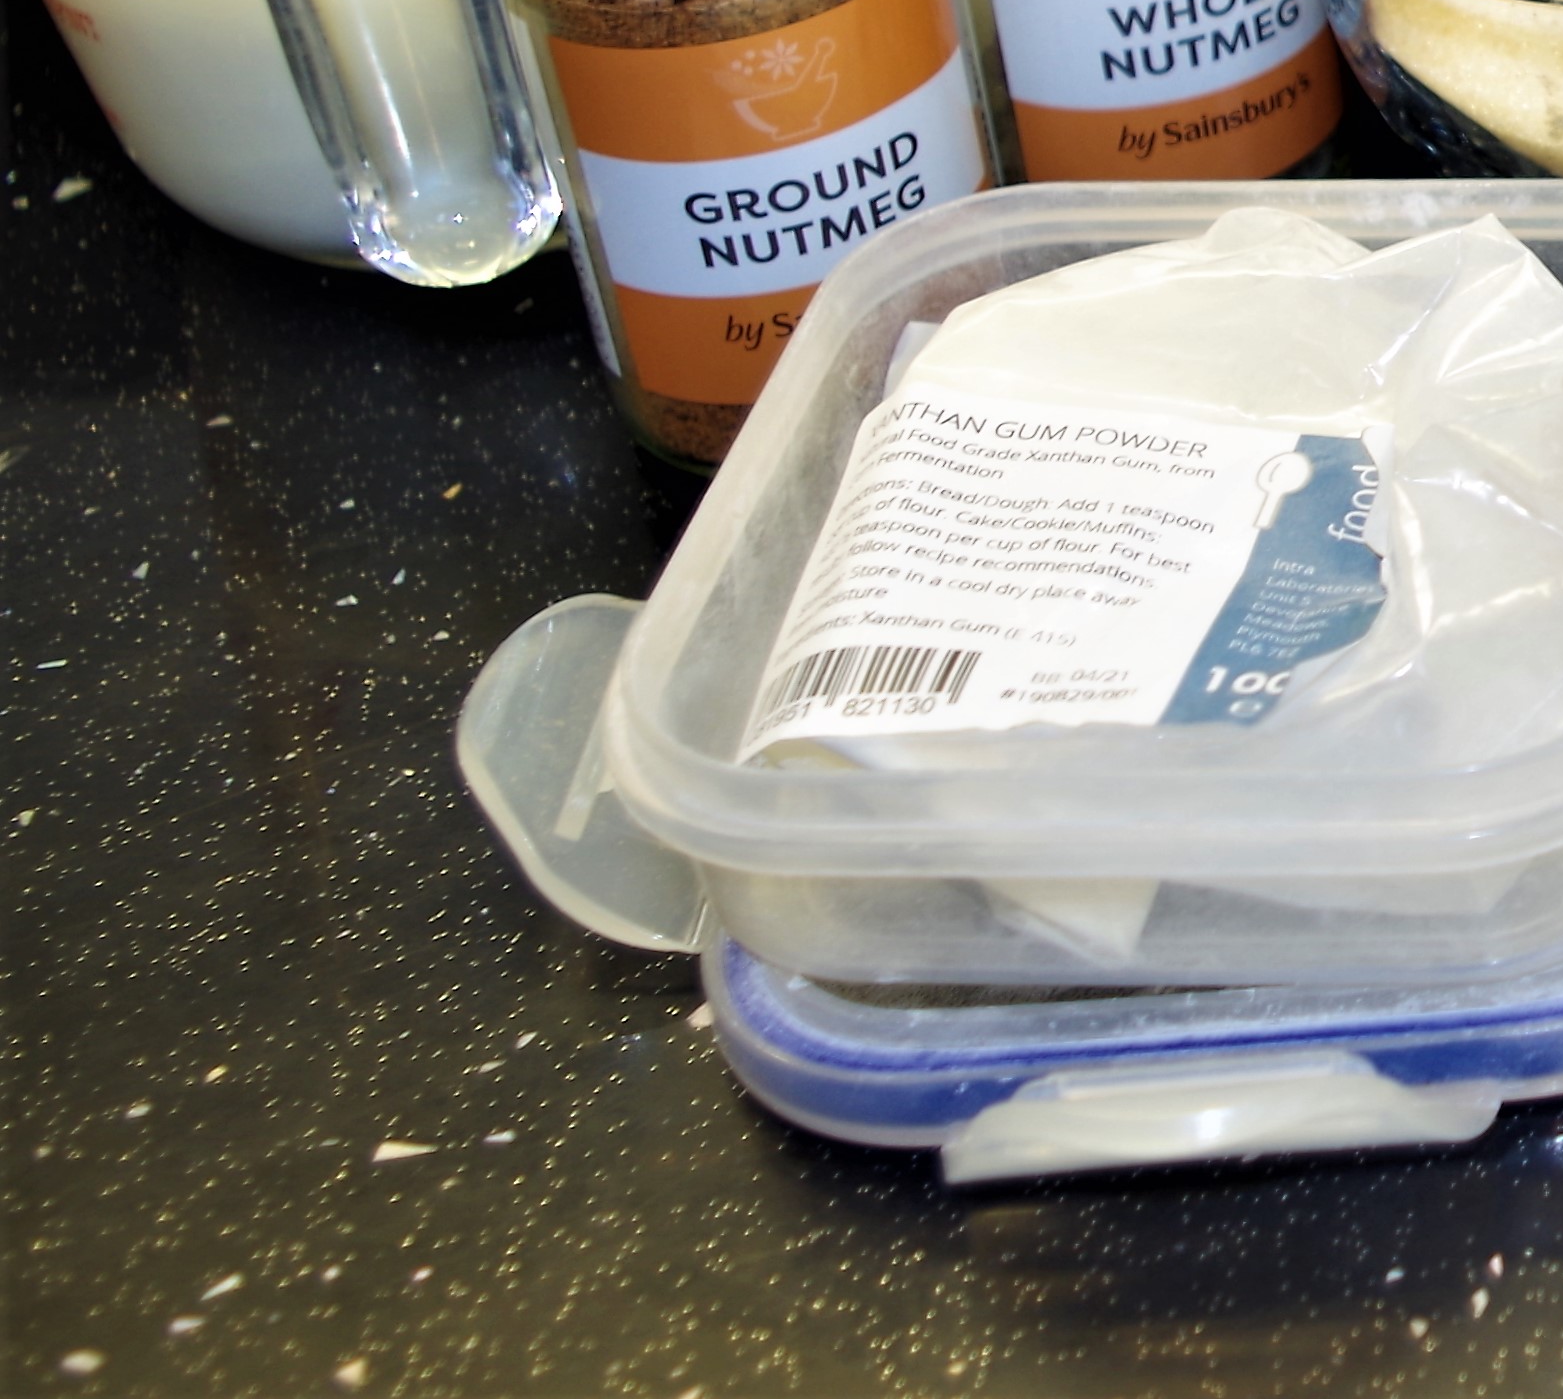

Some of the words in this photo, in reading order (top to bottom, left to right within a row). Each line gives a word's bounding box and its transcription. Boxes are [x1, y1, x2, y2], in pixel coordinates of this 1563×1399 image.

[1117, 125, 1158, 159] by
[1163, 73, 1311, 148] Sainsbury's
[685, 131, 919, 225] GROUND
[699, 174, 926, 269] NUTMEG
[725, 315, 764, 351] by
[908, 429, 957, 450] Food
[962, 442, 1019, 461] Grade
[1025, 449, 1106, 466] Xanthan
[1169, 463, 1216, 480] from
[994, 420, 1068, 441] GUM
[1075, 426, 1208, 459] POWDER
[875, 496, 898, 511] of
[1057, 498, 1099, 513] Add
[1121, 504, 1215, 535] teaspoon
[905, 545, 968, 564] recipe
[945, 531, 980, 546] per
[987, 537, 1023, 553] cup
[1029, 538, 1051, 551] of
[1110, 542, 1144, 562] For
[1147, 551, 1192, 574] best
[1272, 558, 1315, 575] Intra
[905, 569, 925, 584] in
[929, 576, 943, 586] a
[947, 579, 993, 594] cool
[995, 583, 1029, 600] dry
[1031, 584, 1087, 600] place
[860, 610, 944, 630] Xanthan
[950, 619, 1001, 635] Gum
[842, 696, 936, 717] 821130
